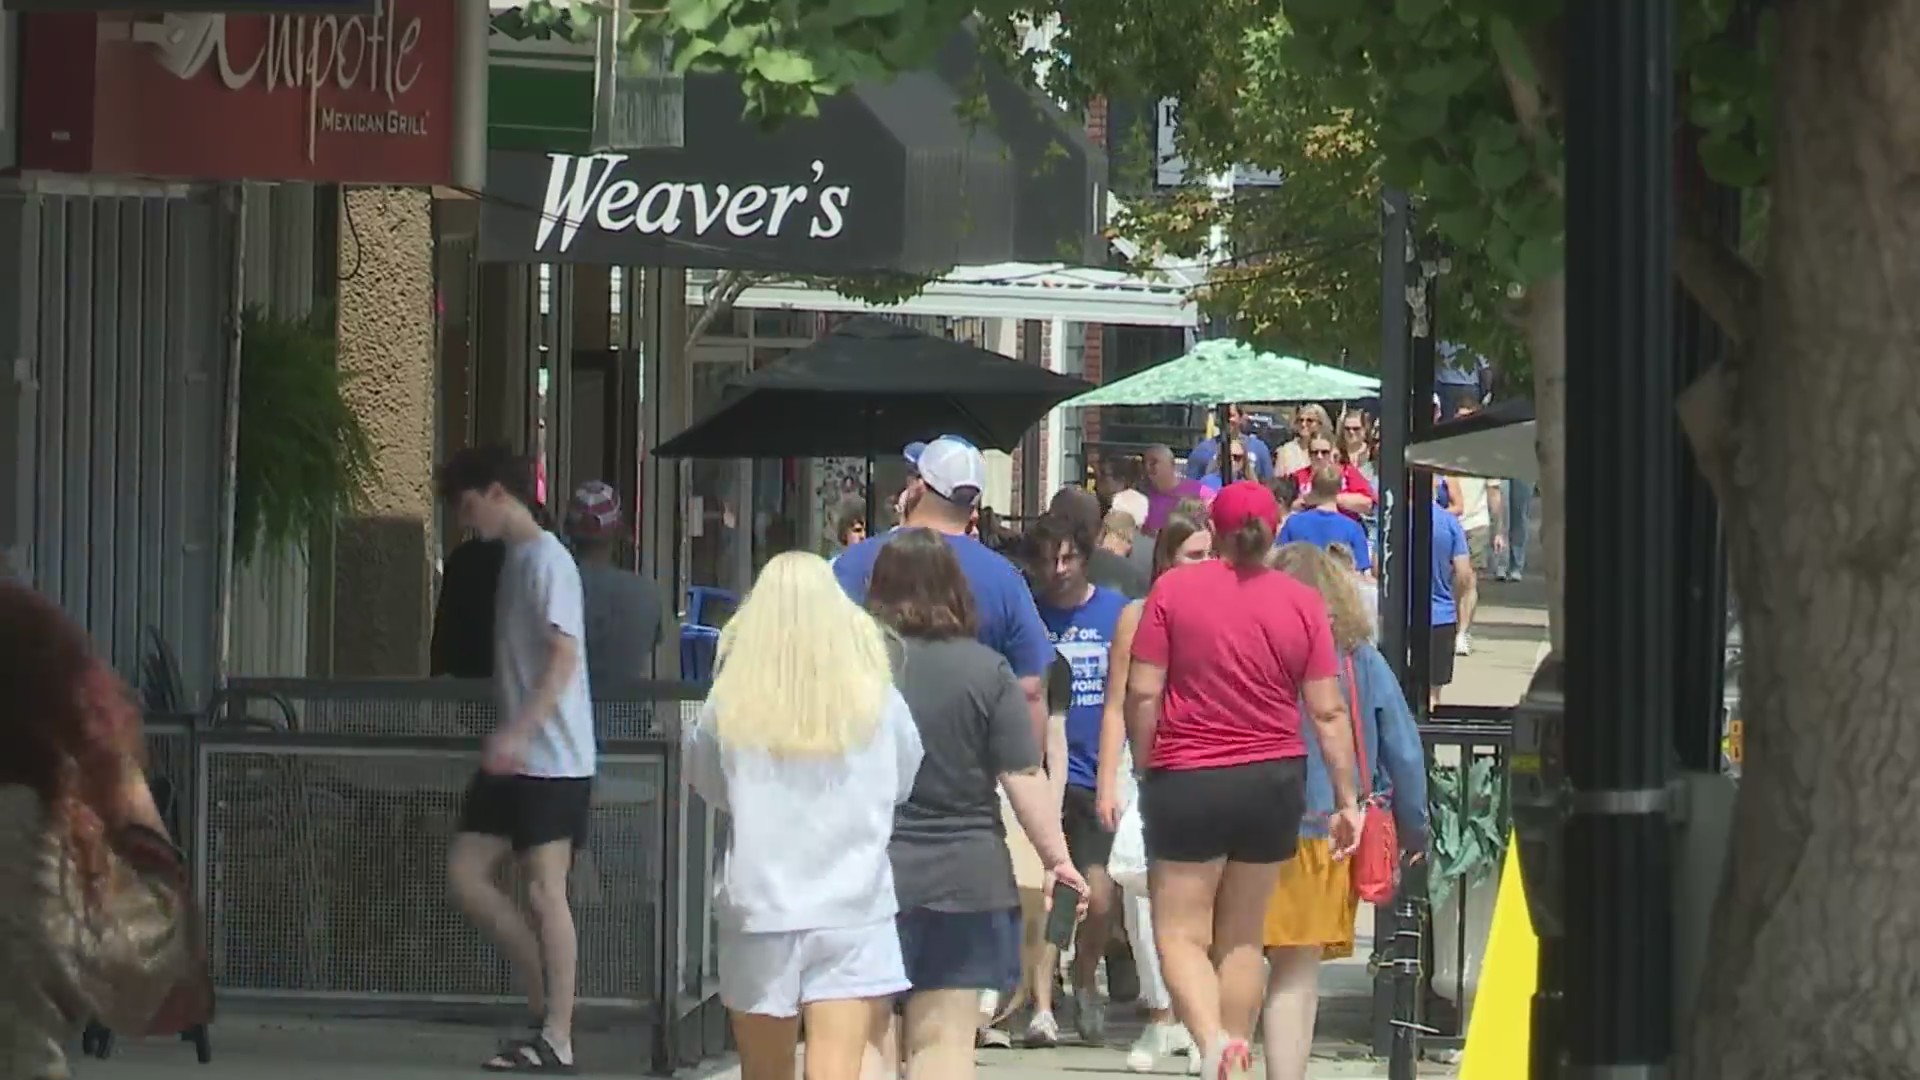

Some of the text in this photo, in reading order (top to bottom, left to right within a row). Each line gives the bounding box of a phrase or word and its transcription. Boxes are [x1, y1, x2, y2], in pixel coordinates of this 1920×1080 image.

[321, 108, 427, 135] MEXICAN GRILL
[535, 152, 850, 252] Weaver's
